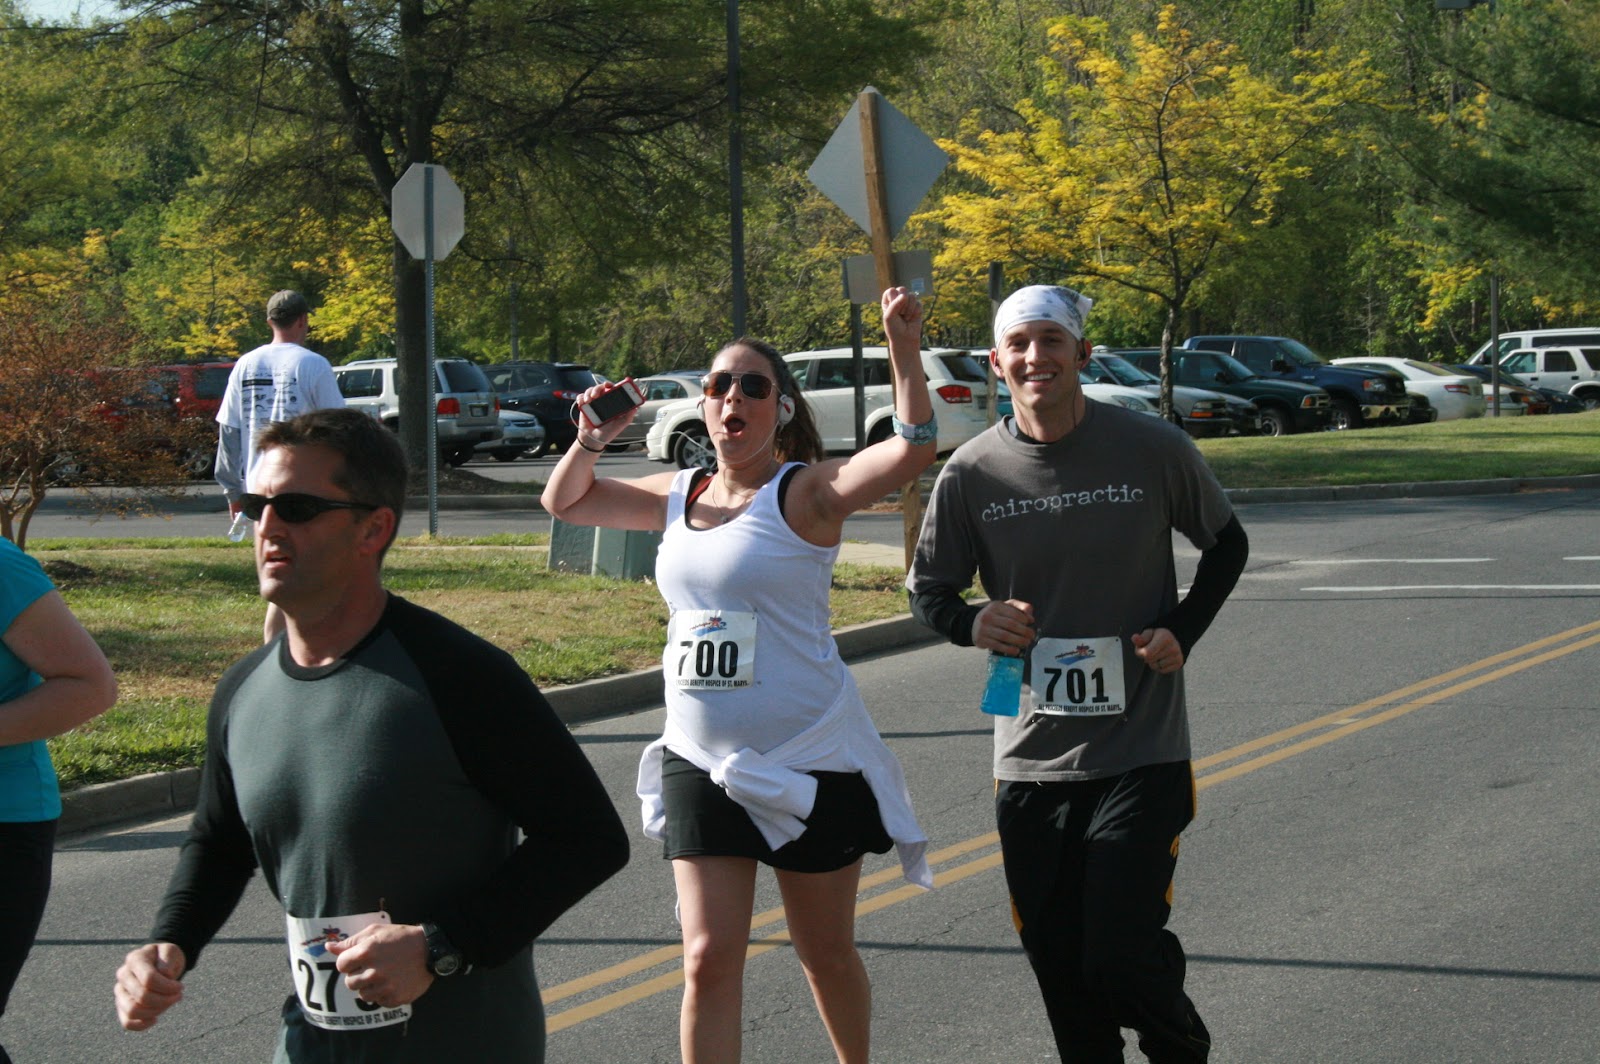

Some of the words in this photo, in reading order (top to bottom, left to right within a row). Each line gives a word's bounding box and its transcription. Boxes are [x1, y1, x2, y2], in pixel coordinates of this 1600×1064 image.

[981, 484, 1144, 523] chiropractic
[677, 640, 739, 678] 700
[1044, 668, 1110, 704] 701
[1078, 705, 1094, 713] HOSPICE
[298, 958, 382, 1013] 27
